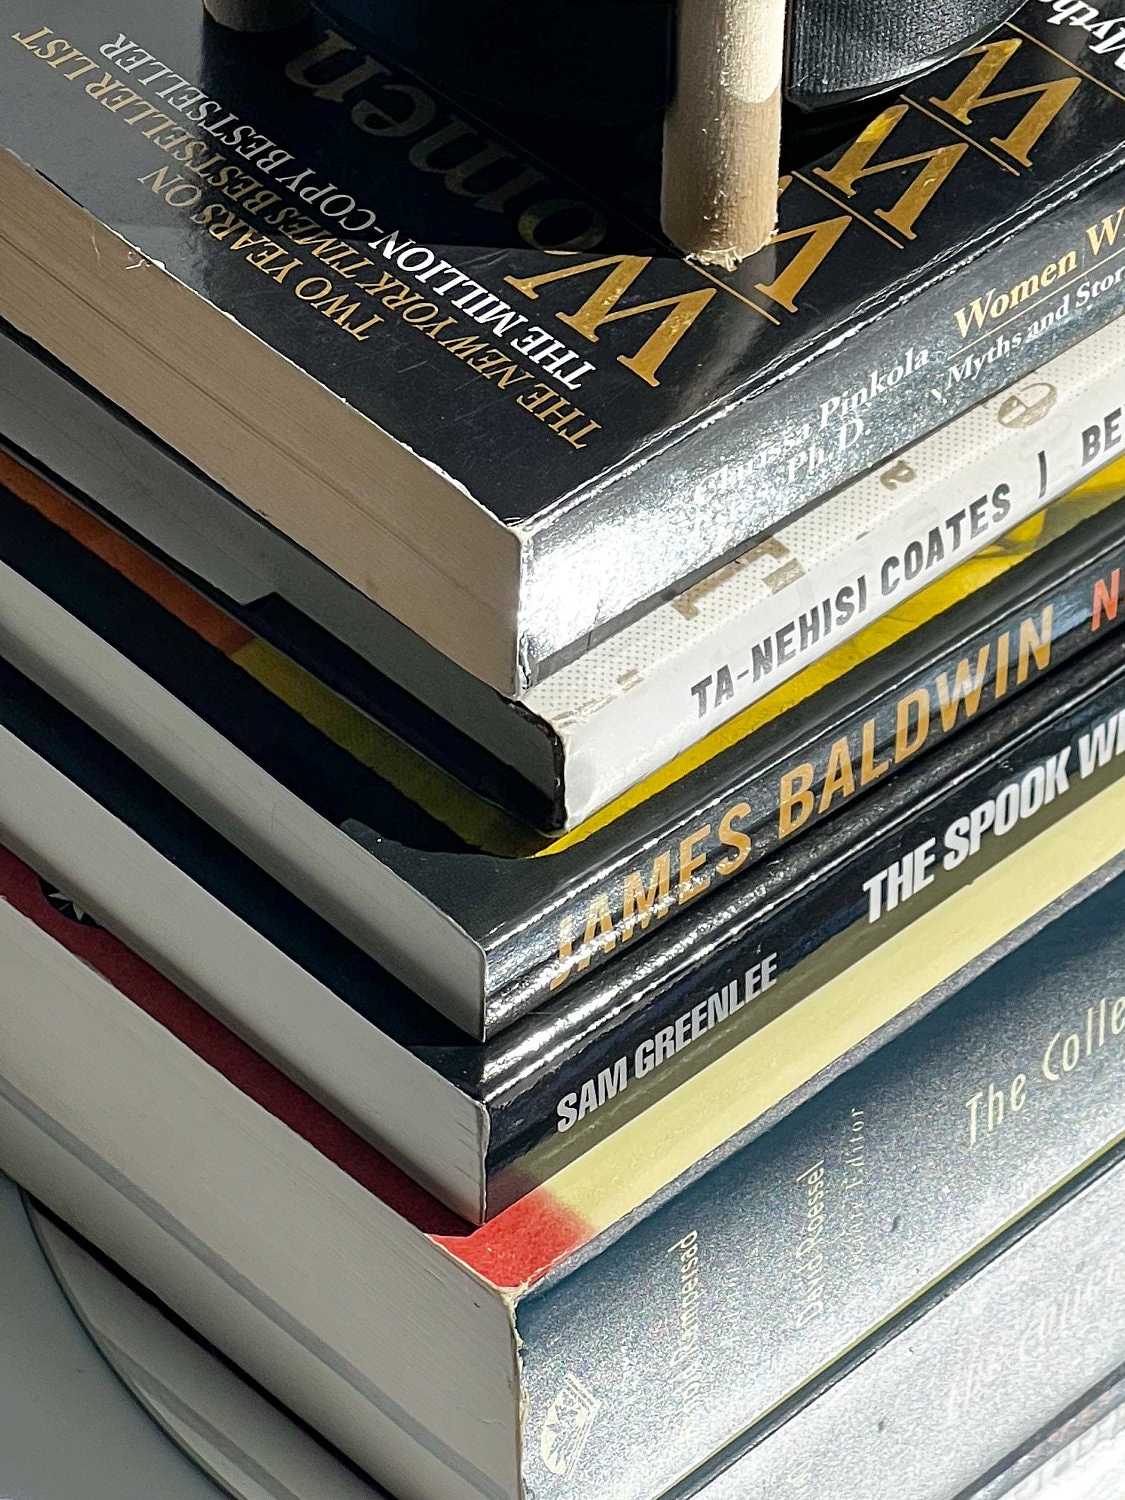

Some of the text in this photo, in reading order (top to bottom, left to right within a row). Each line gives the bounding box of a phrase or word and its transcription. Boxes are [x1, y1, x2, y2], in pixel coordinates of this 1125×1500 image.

[12, 26, 602, 450] THE NEW YORK TIMES BESTSELLER LIST
[100, 33, 597, 390] THE MILLION-COPY BESTSELLER
[137, 165, 384, 341] TWO YEARS ON
[284, 28, 716, 387] Women
[953, 249, 1078, 338] Women
[819, 347, 930, 429] Pinkola
[946, 332, 1022, 388] Myths
[1027, 294, 1070, 337] and
[690, 574, 868, 719] TA-NEHISI
[880, 482, 1011, 597] COATES
[550, 801, 752, 991] JAMES
[777, 605, 1053, 839] BALDWIN
[557, 1056, 628, 1133] SAM
[635, 952, 778, 1079] GREENLEE
[862, 852, 937, 924] THE
[943, 746, 1074, 871] SPOOK
[965, 1073, 1027, 1147] The
